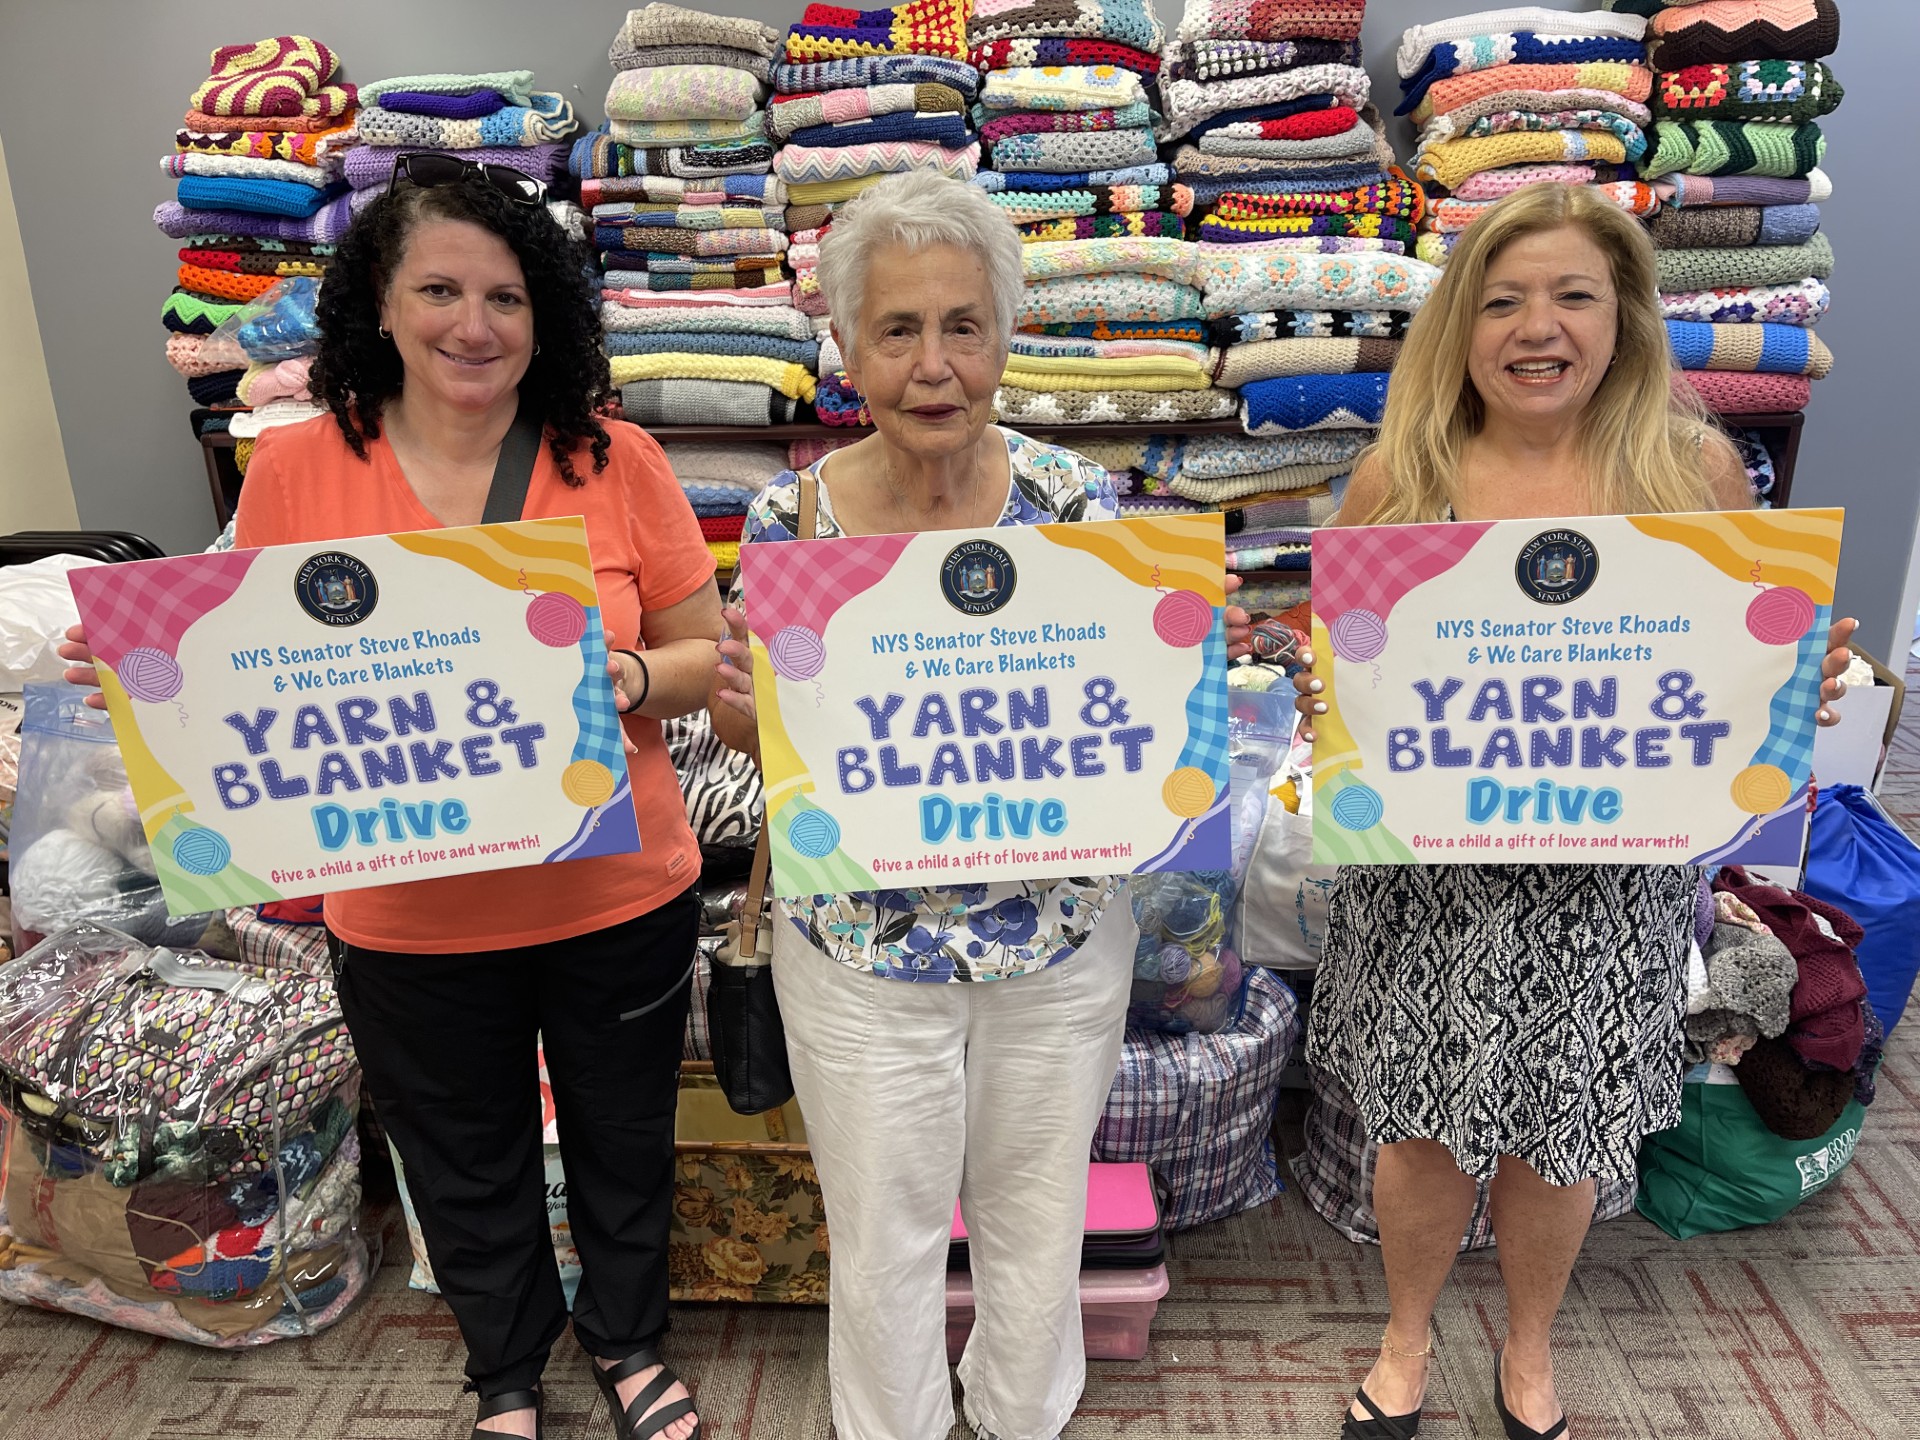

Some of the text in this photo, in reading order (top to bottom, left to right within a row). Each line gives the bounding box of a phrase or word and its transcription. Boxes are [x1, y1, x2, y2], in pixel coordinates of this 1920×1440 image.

[945, 542, 1011, 571] NEW YORK STATE
[1522, 532, 1594, 561] NEW YORK STATE
[300, 556, 368, 585] NEW YORK STATE
[962, 601, 997, 613] SENATE
[1536, 590, 1573, 602] SENATE
[325, 612, 361, 624] SENATE
[1436, 615, 1691, 639] NYS Senator Steve Rhoads
[231, 627, 481, 670] NYS Senator Steve Rhoads
[871, 622, 1106, 654] NYS Senator Steve Rhoads
[1468, 643, 1653, 664] & We Care Blankets
[273, 657, 454, 693] & We Care Blankets
[905, 651, 1076, 679] & We Care Blankets
[853, 676, 1132, 741] YARN &
[1410, 668, 1709, 724] YARN &
[222, 678, 520, 756] YARN &
[836, 723, 1155, 794] BLANKET
[1386, 719, 1733, 774] BLANKET
[212, 722, 546, 811] BLANKET
[1465, 775, 1624, 825] Drive
[310, 797, 471, 851] Drive
[919, 792, 1068, 845] Drive
[872, 842, 1133, 873] Give a child a gift of love and warmth!
[1413, 834, 1690, 850] Give a child a gift of love and warmth!
[271, 834, 541, 884] Give a child a gift of love and warmth!
[1828, 1128, 1855, 1156] GOOD
